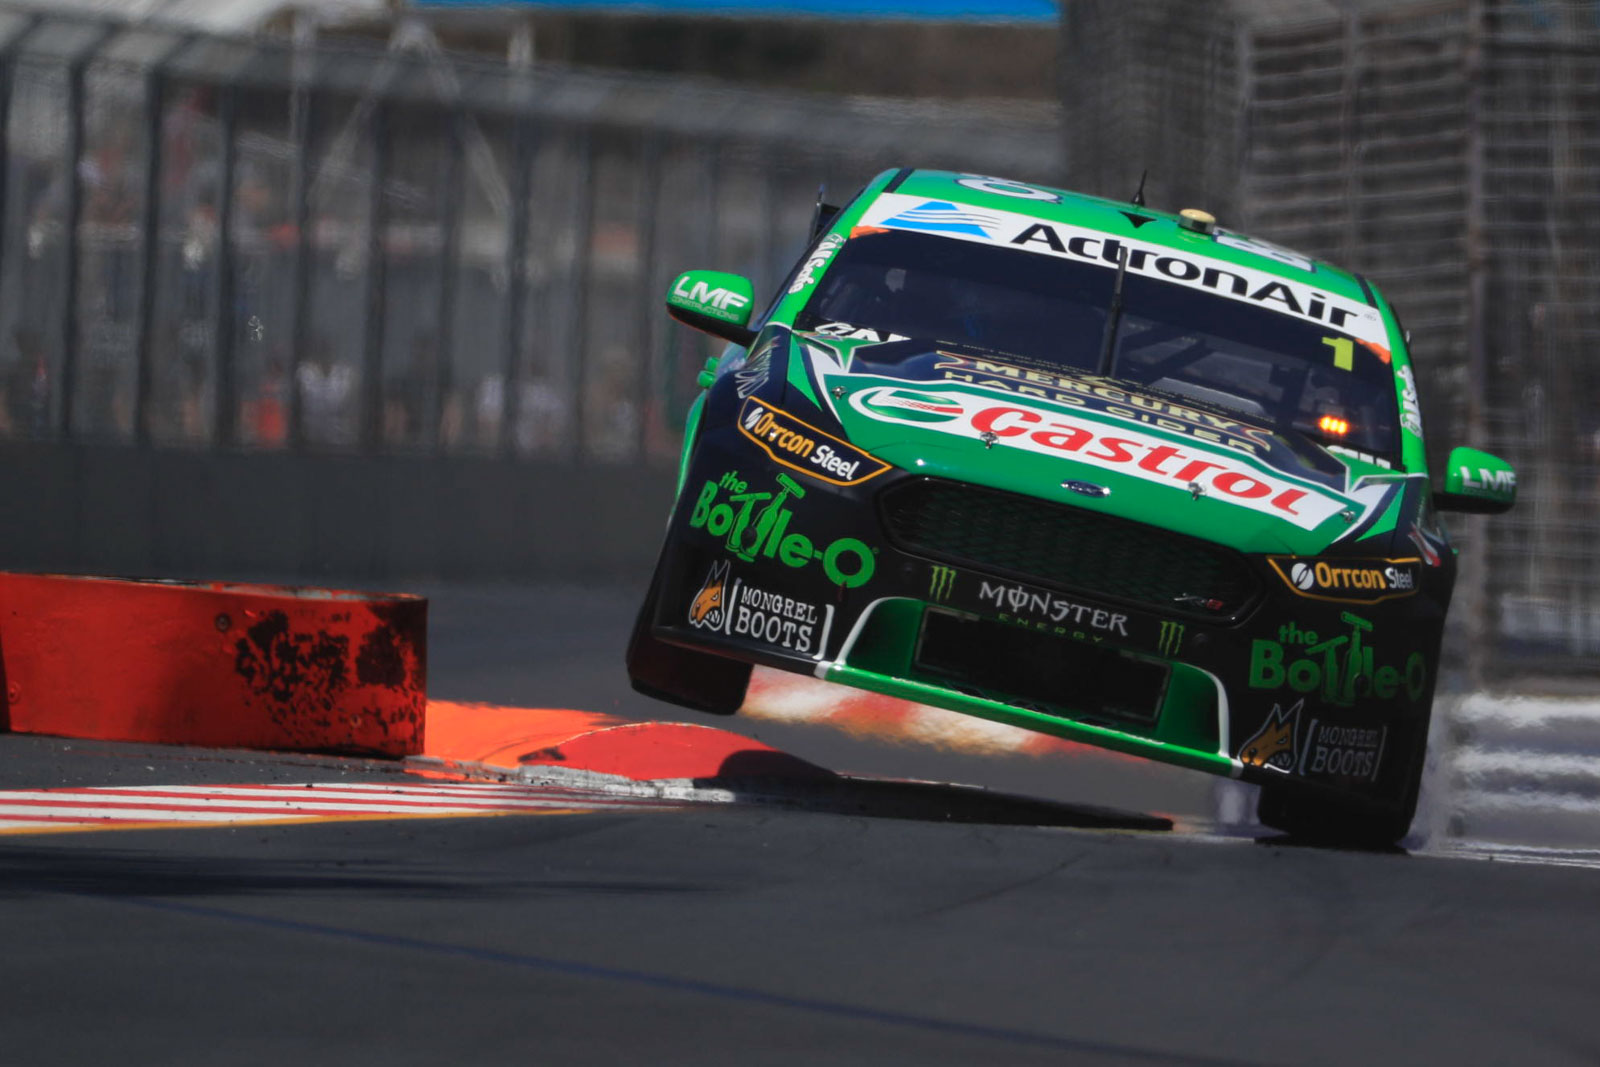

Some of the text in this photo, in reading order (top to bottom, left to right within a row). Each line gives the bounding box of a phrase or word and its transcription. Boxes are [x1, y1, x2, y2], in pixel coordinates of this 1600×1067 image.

[673, 276, 750, 310] LMF
[1010, 223, 1358, 328] ActronAir
[1322, 336, 1354, 372] 1
[944, 371, 1257, 454] HARD CIDER
[975, 360, 1241, 431] MERCURY
[754, 411, 860, 481] Orrcon Steel
[970, 406, 1309, 516] Castrol
[719, 471, 748, 494] the
[1460, 465, 1517, 494] LMF
[1315, 561, 1386, 590] Orrcon
[740, 585, 818, 625] MONGREL
[979, 580, 1129, 637] MONSTER
[735, 605, 813, 653] BOOTS
[998, 612, 1104, 643] ENERGY
[1278, 621, 1319, 645] the
[1311, 745, 1375, 777] BOOTS
